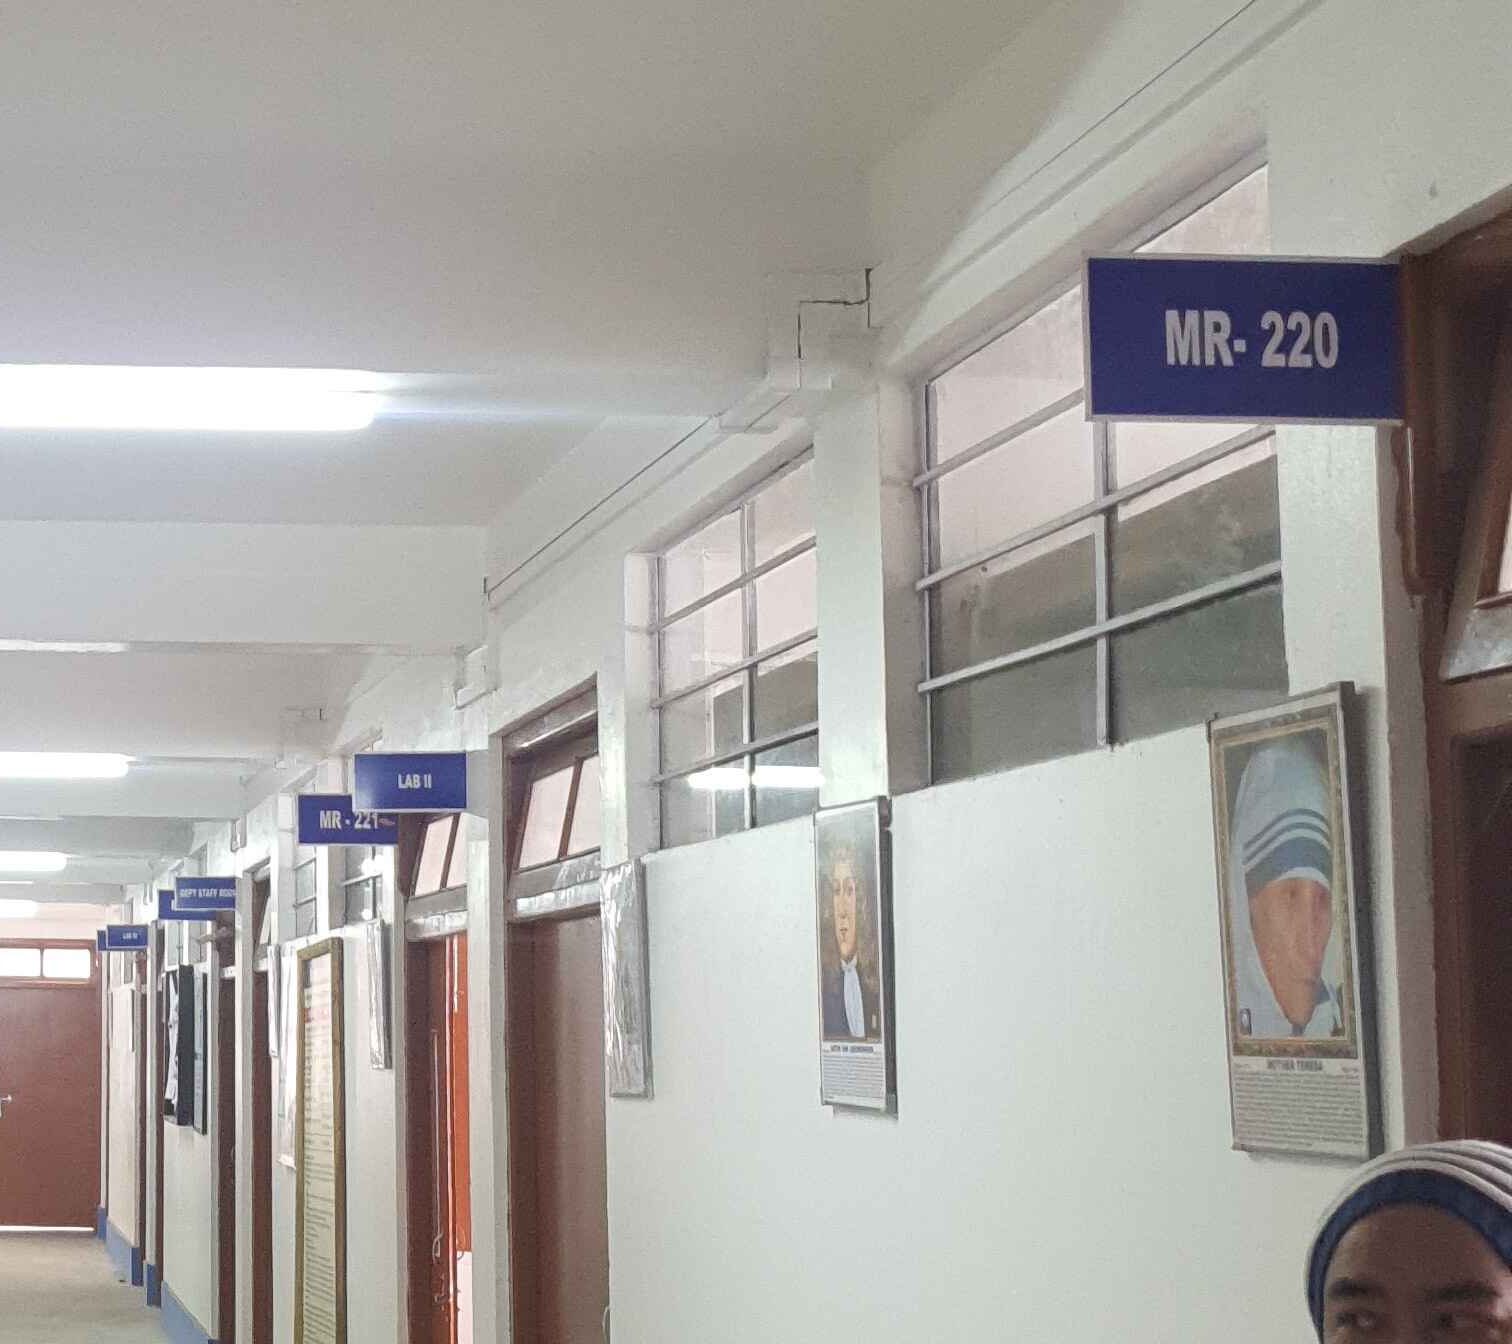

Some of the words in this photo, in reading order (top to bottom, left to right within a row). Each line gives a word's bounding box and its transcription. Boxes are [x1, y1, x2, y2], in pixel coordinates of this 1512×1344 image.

[1260, 310, 1339, 368] 220
[397, 773, 420, 789] LAB
[423, 773, 433, 789] II
[319, 810, 342, 829] MR
[354, 810, 379, 829] 221
